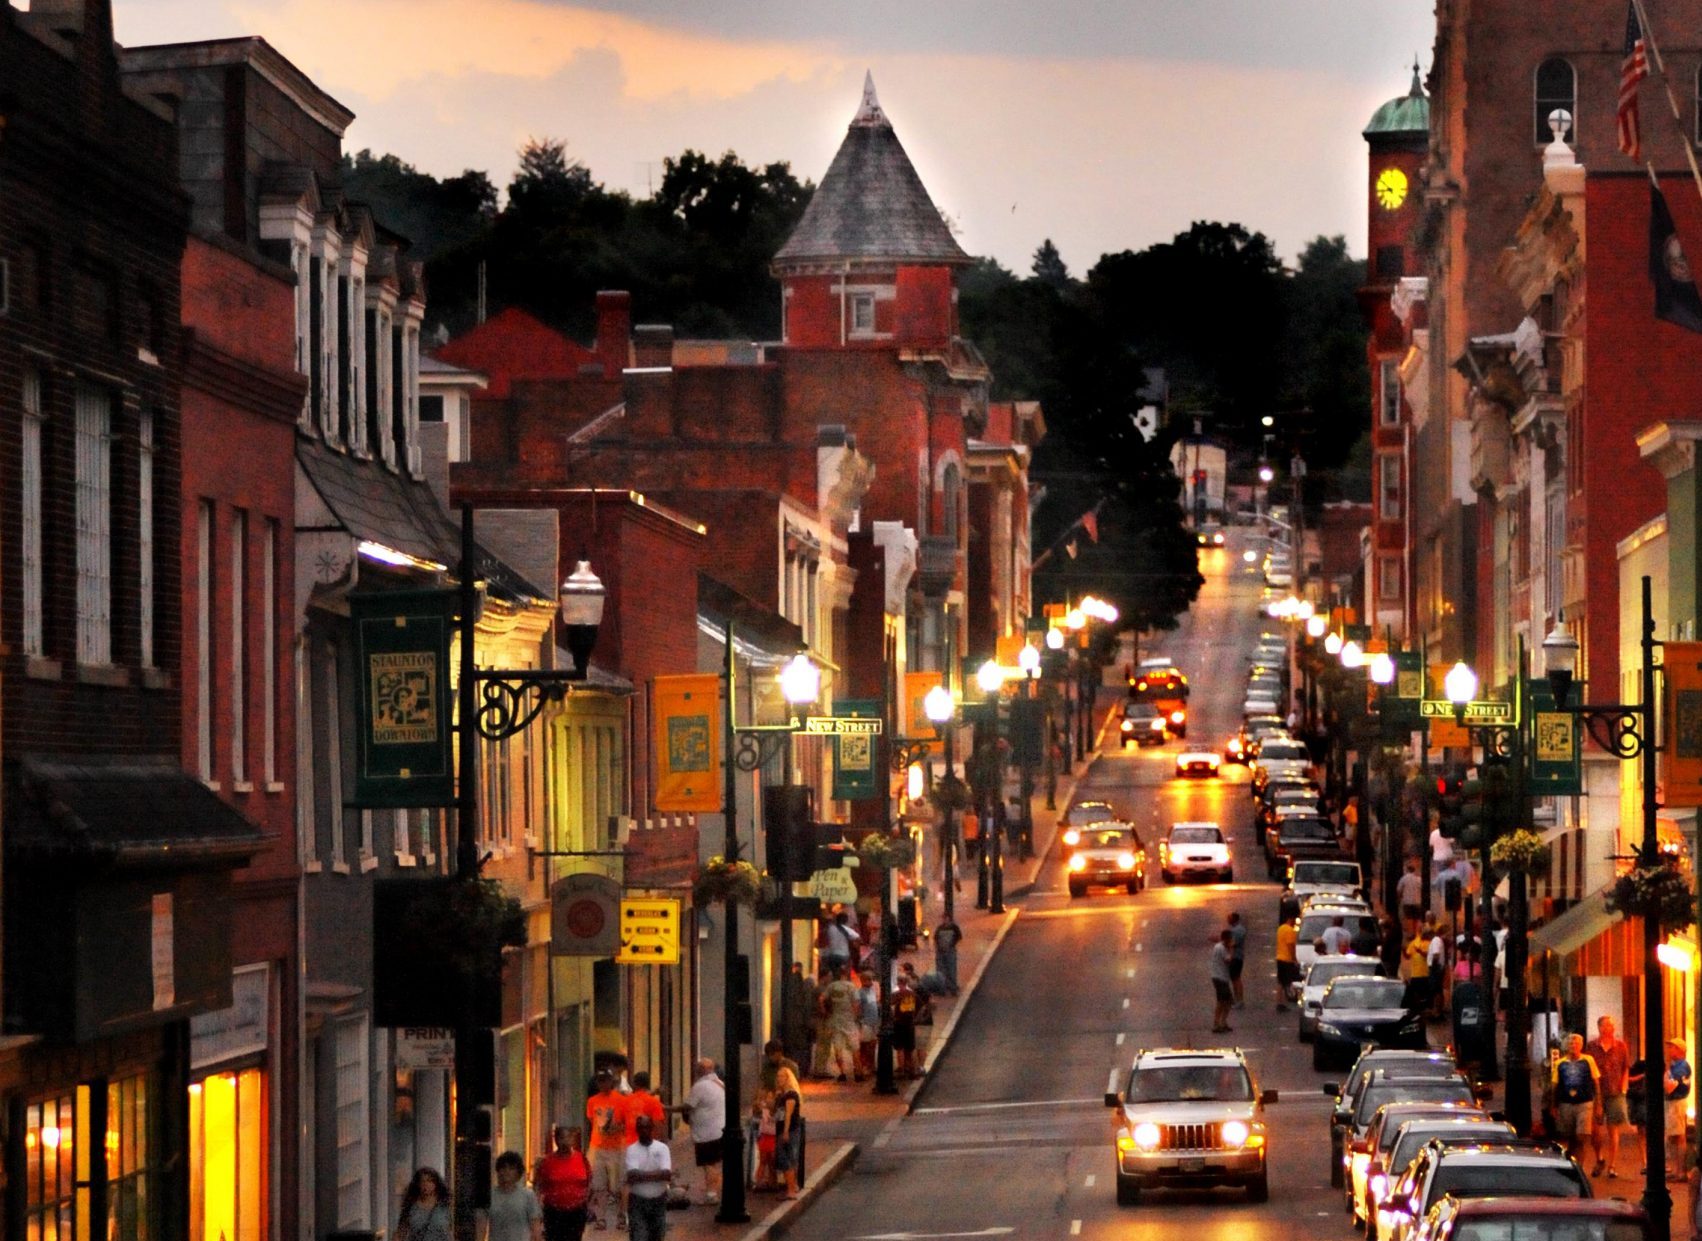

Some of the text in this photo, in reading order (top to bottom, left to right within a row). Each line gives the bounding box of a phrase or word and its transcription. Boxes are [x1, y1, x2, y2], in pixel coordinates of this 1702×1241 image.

[371, 654, 434, 667] STAUNTON
[1435, 703, 1506, 715] NE STREET
[806, 719, 878, 732] NEW STREET
[374, 728, 436, 741] DOWNTOWN
[815, 870, 838, 882] Pen
[815, 883, 848, 900] Paper
